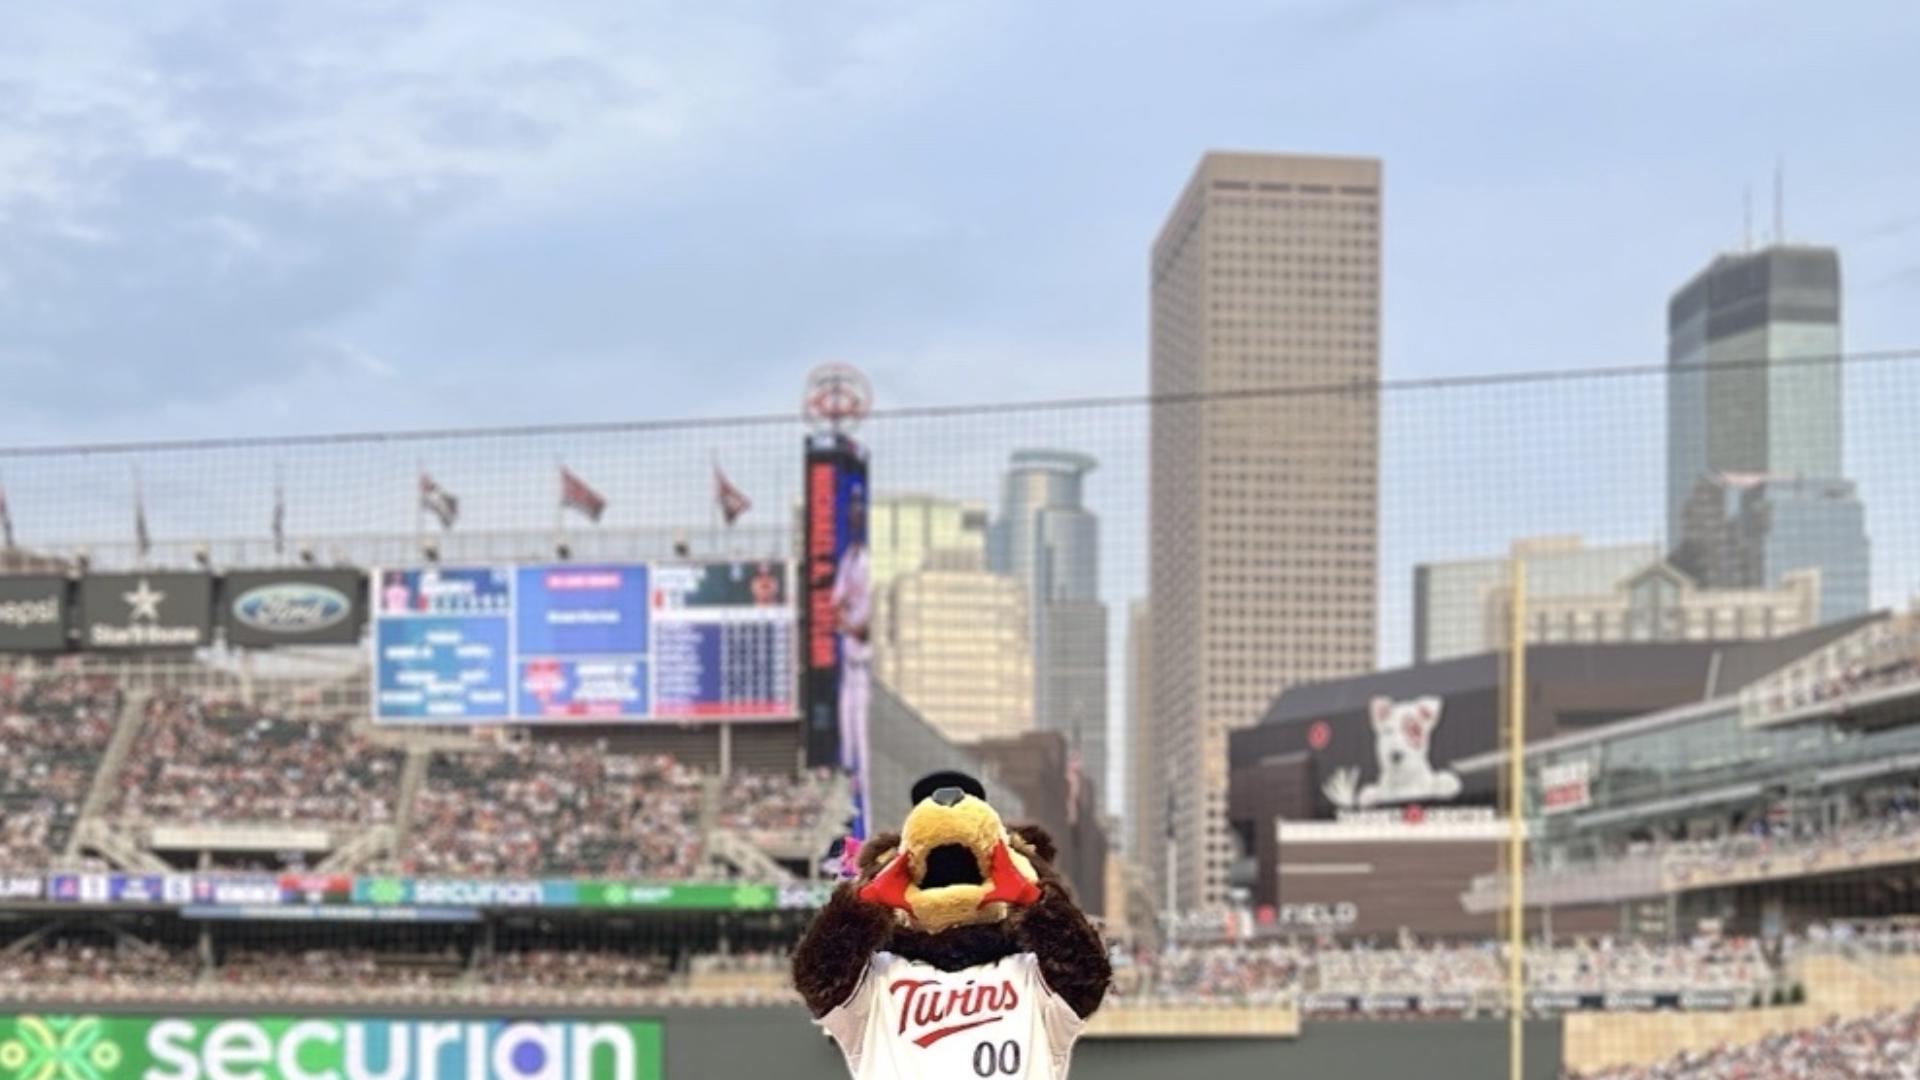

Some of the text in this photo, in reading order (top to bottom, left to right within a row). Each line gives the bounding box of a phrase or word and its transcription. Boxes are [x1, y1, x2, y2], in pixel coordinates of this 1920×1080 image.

[889, 979, 1019, 1036] Twins
[144, 1019, 637, 1080] securian
[972, 1040, 1021, 1078] 00
